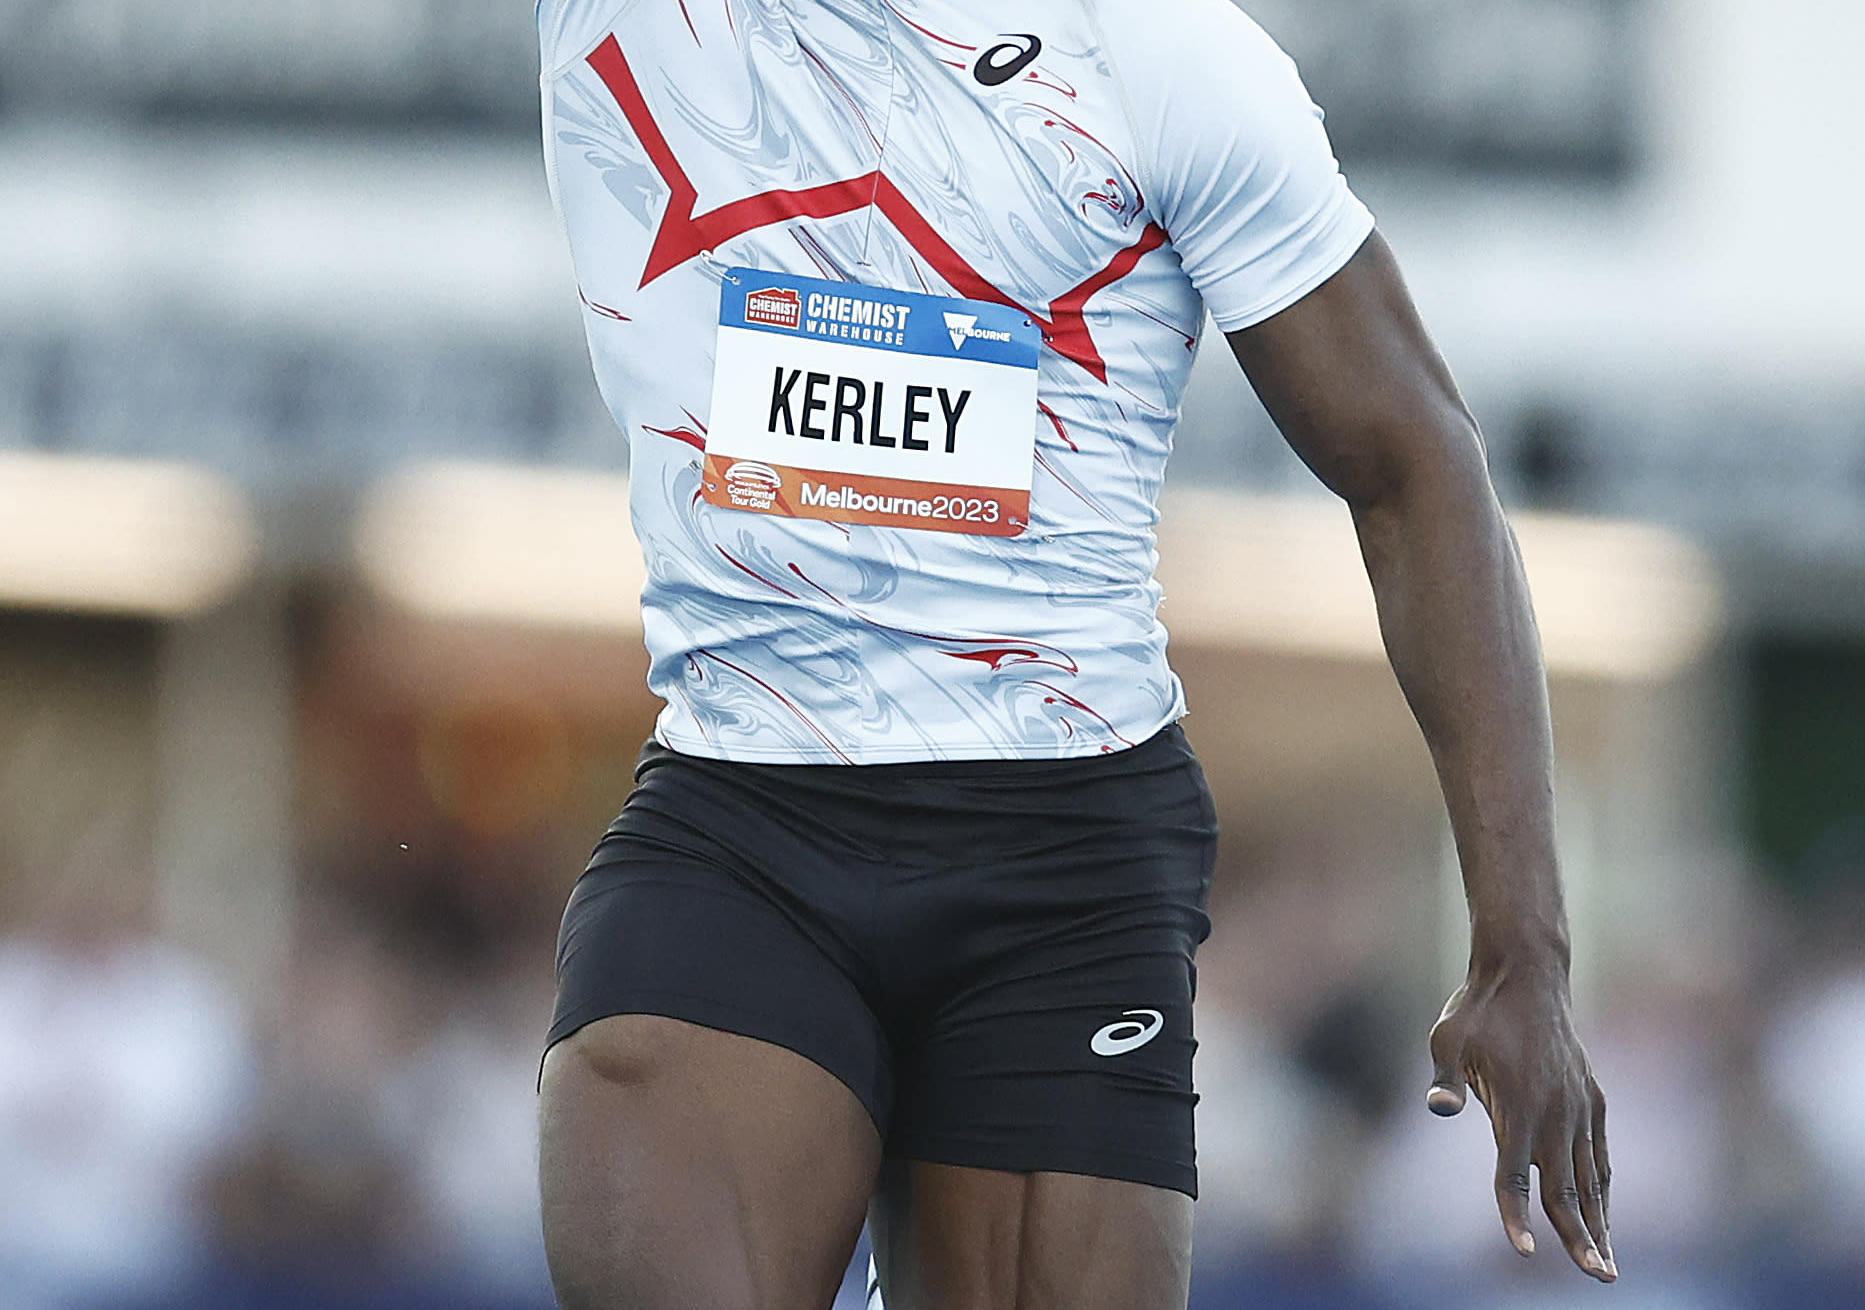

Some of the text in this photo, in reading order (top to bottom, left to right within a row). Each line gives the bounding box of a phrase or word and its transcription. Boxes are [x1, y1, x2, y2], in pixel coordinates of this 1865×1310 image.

[749, 297, 798, 317] CHEMIST
[807, 292, 911, 330] CHEMIST
[806, 319, 904, 346] WAREHOUSE
[767, 366, 972, 454] KERLEY
[727, 484, 777, 501] Continental
[730, 495, 771, 510] Tour Gold
[800, 482, 1000, 523] Melbourne2023
